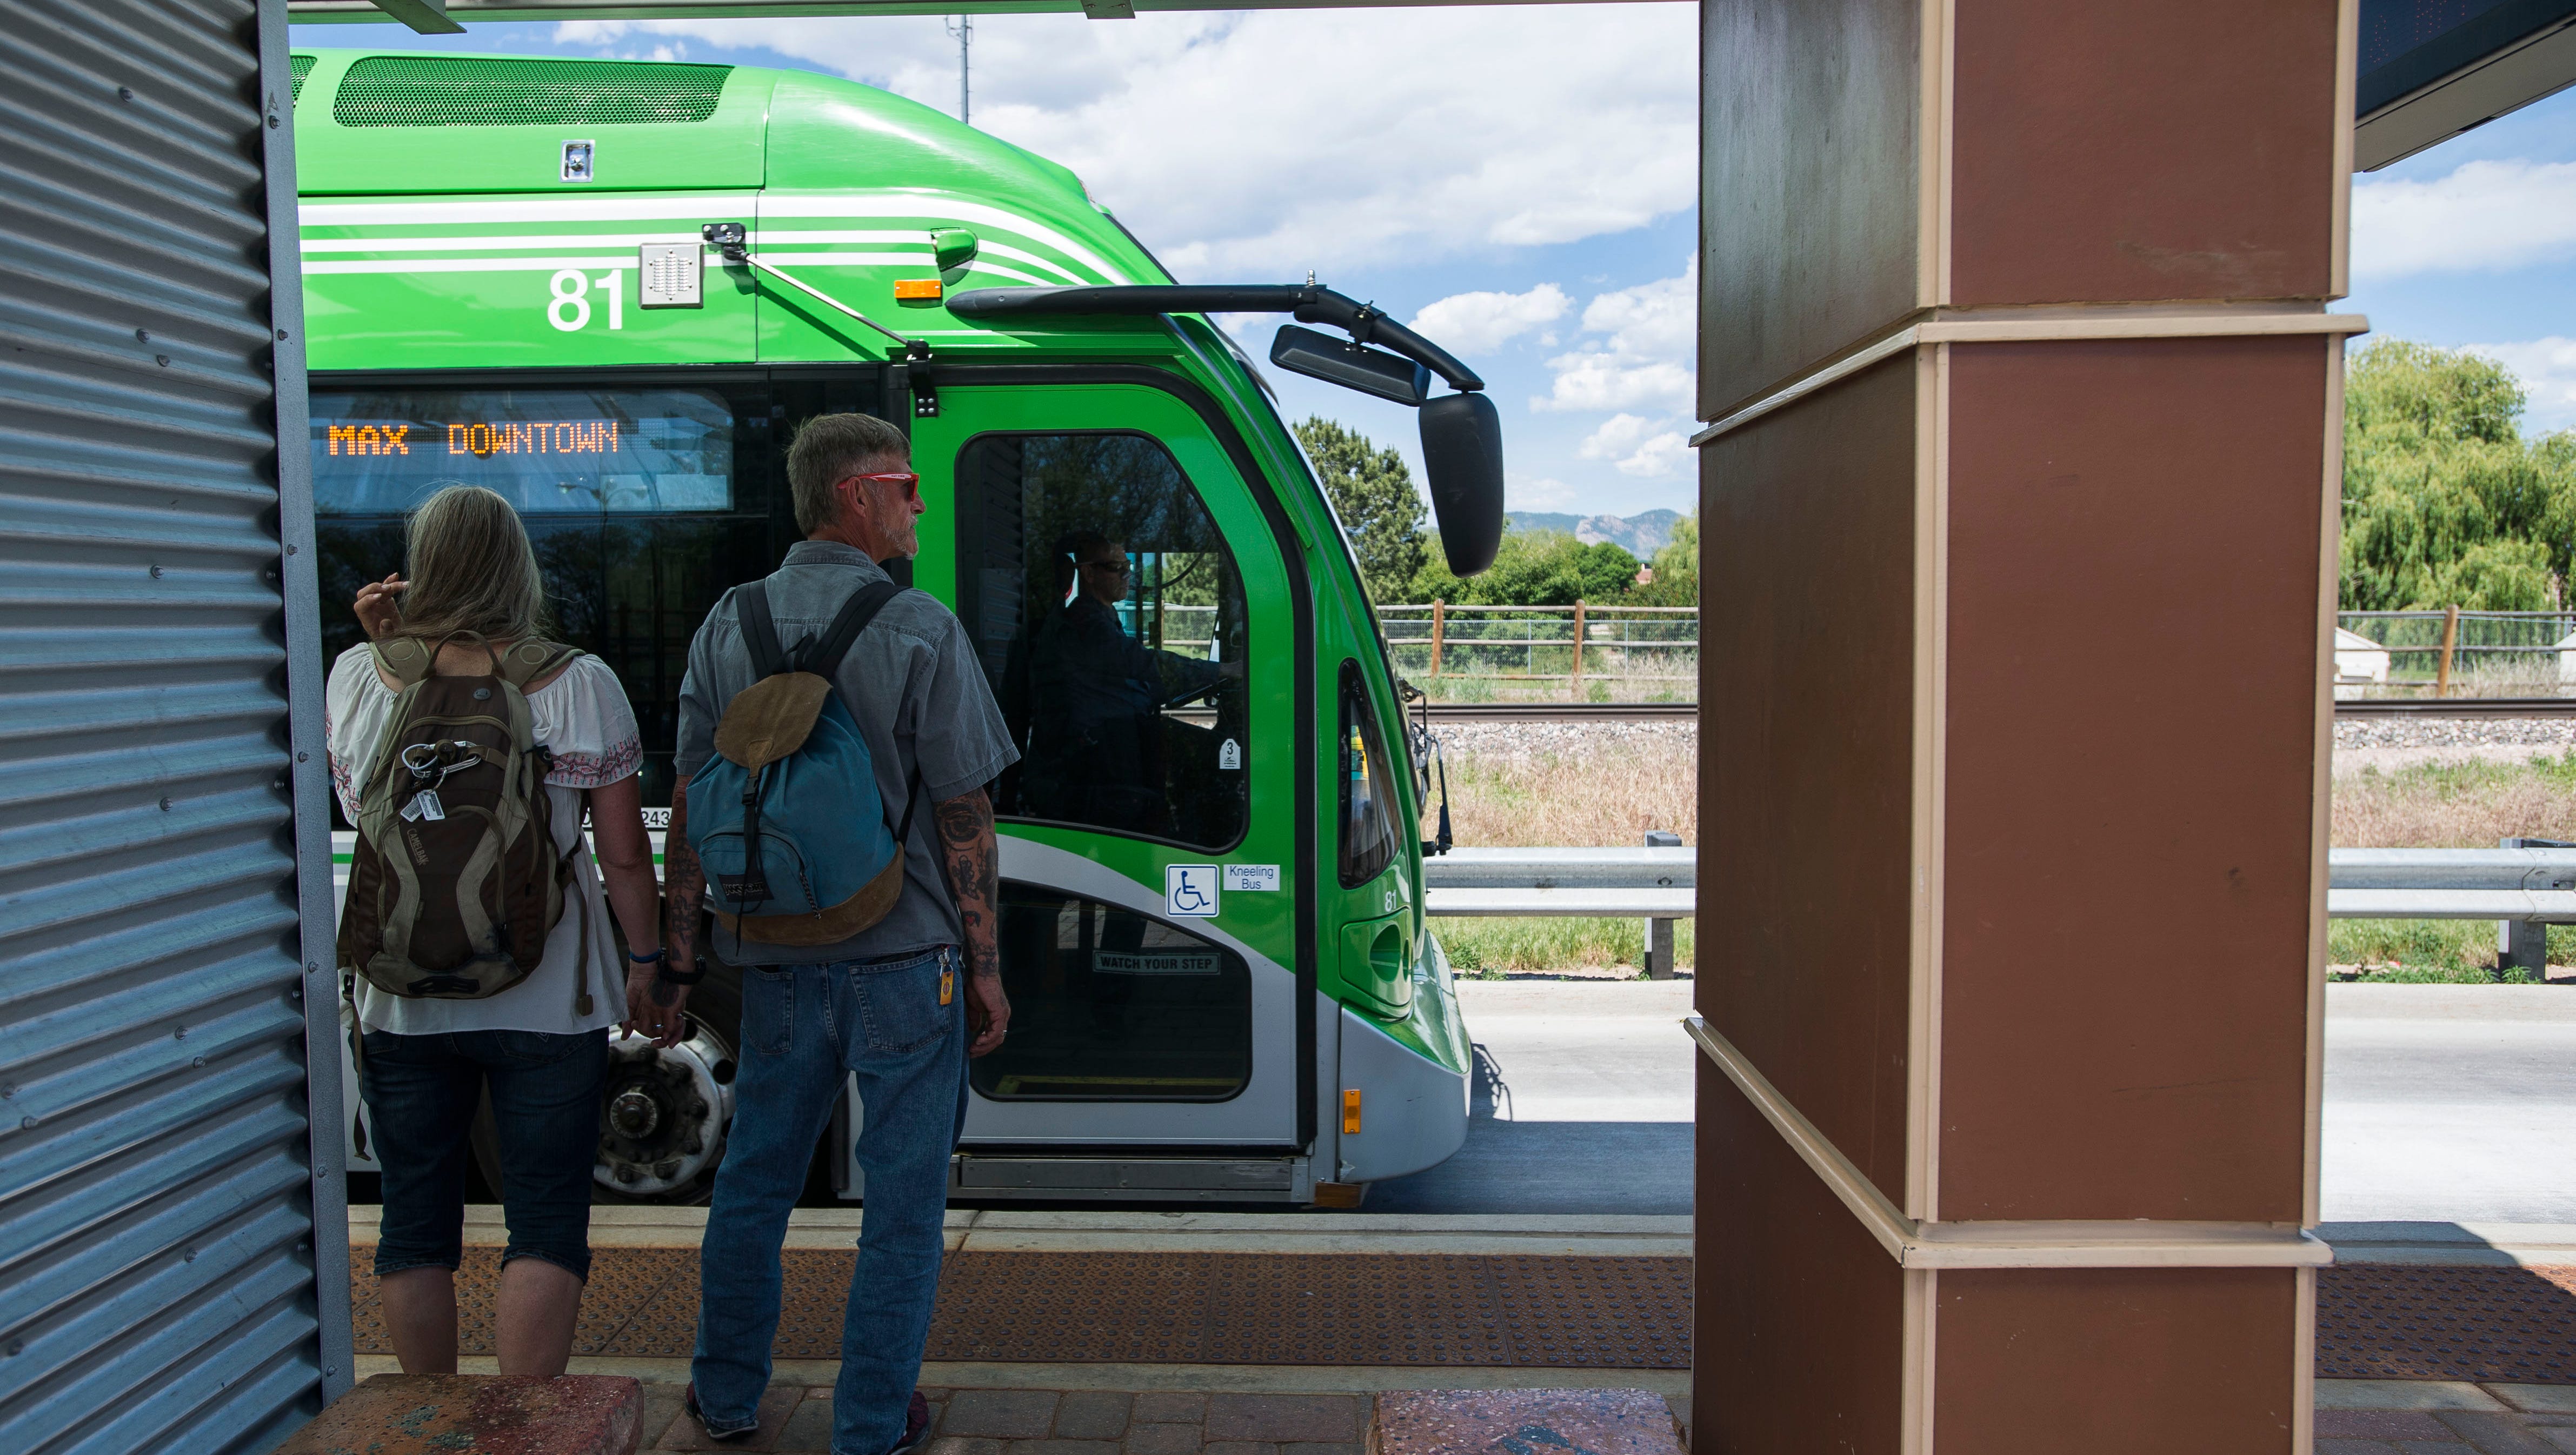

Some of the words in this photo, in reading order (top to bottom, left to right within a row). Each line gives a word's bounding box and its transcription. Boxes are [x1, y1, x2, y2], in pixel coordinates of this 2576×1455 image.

[547, 269, 622, 332] 81
[329, 425, 409, 455] MAX
[449, 422, 617, 454] DOWNTOWN
[1227, 742, 1234, 755] 3
[407, 828, 430, 866] CAMELBAK
[1229, 866, 1273, 879] Kneeling
[1242, 878, 1261, 889] Bus
[1385, 889, 1397, 912] 81
[1101, 956, 1141, 970] WATCH
[1144, 959, 1177, 970] YOUR
[1182, 958, 1212, 970] STEP
